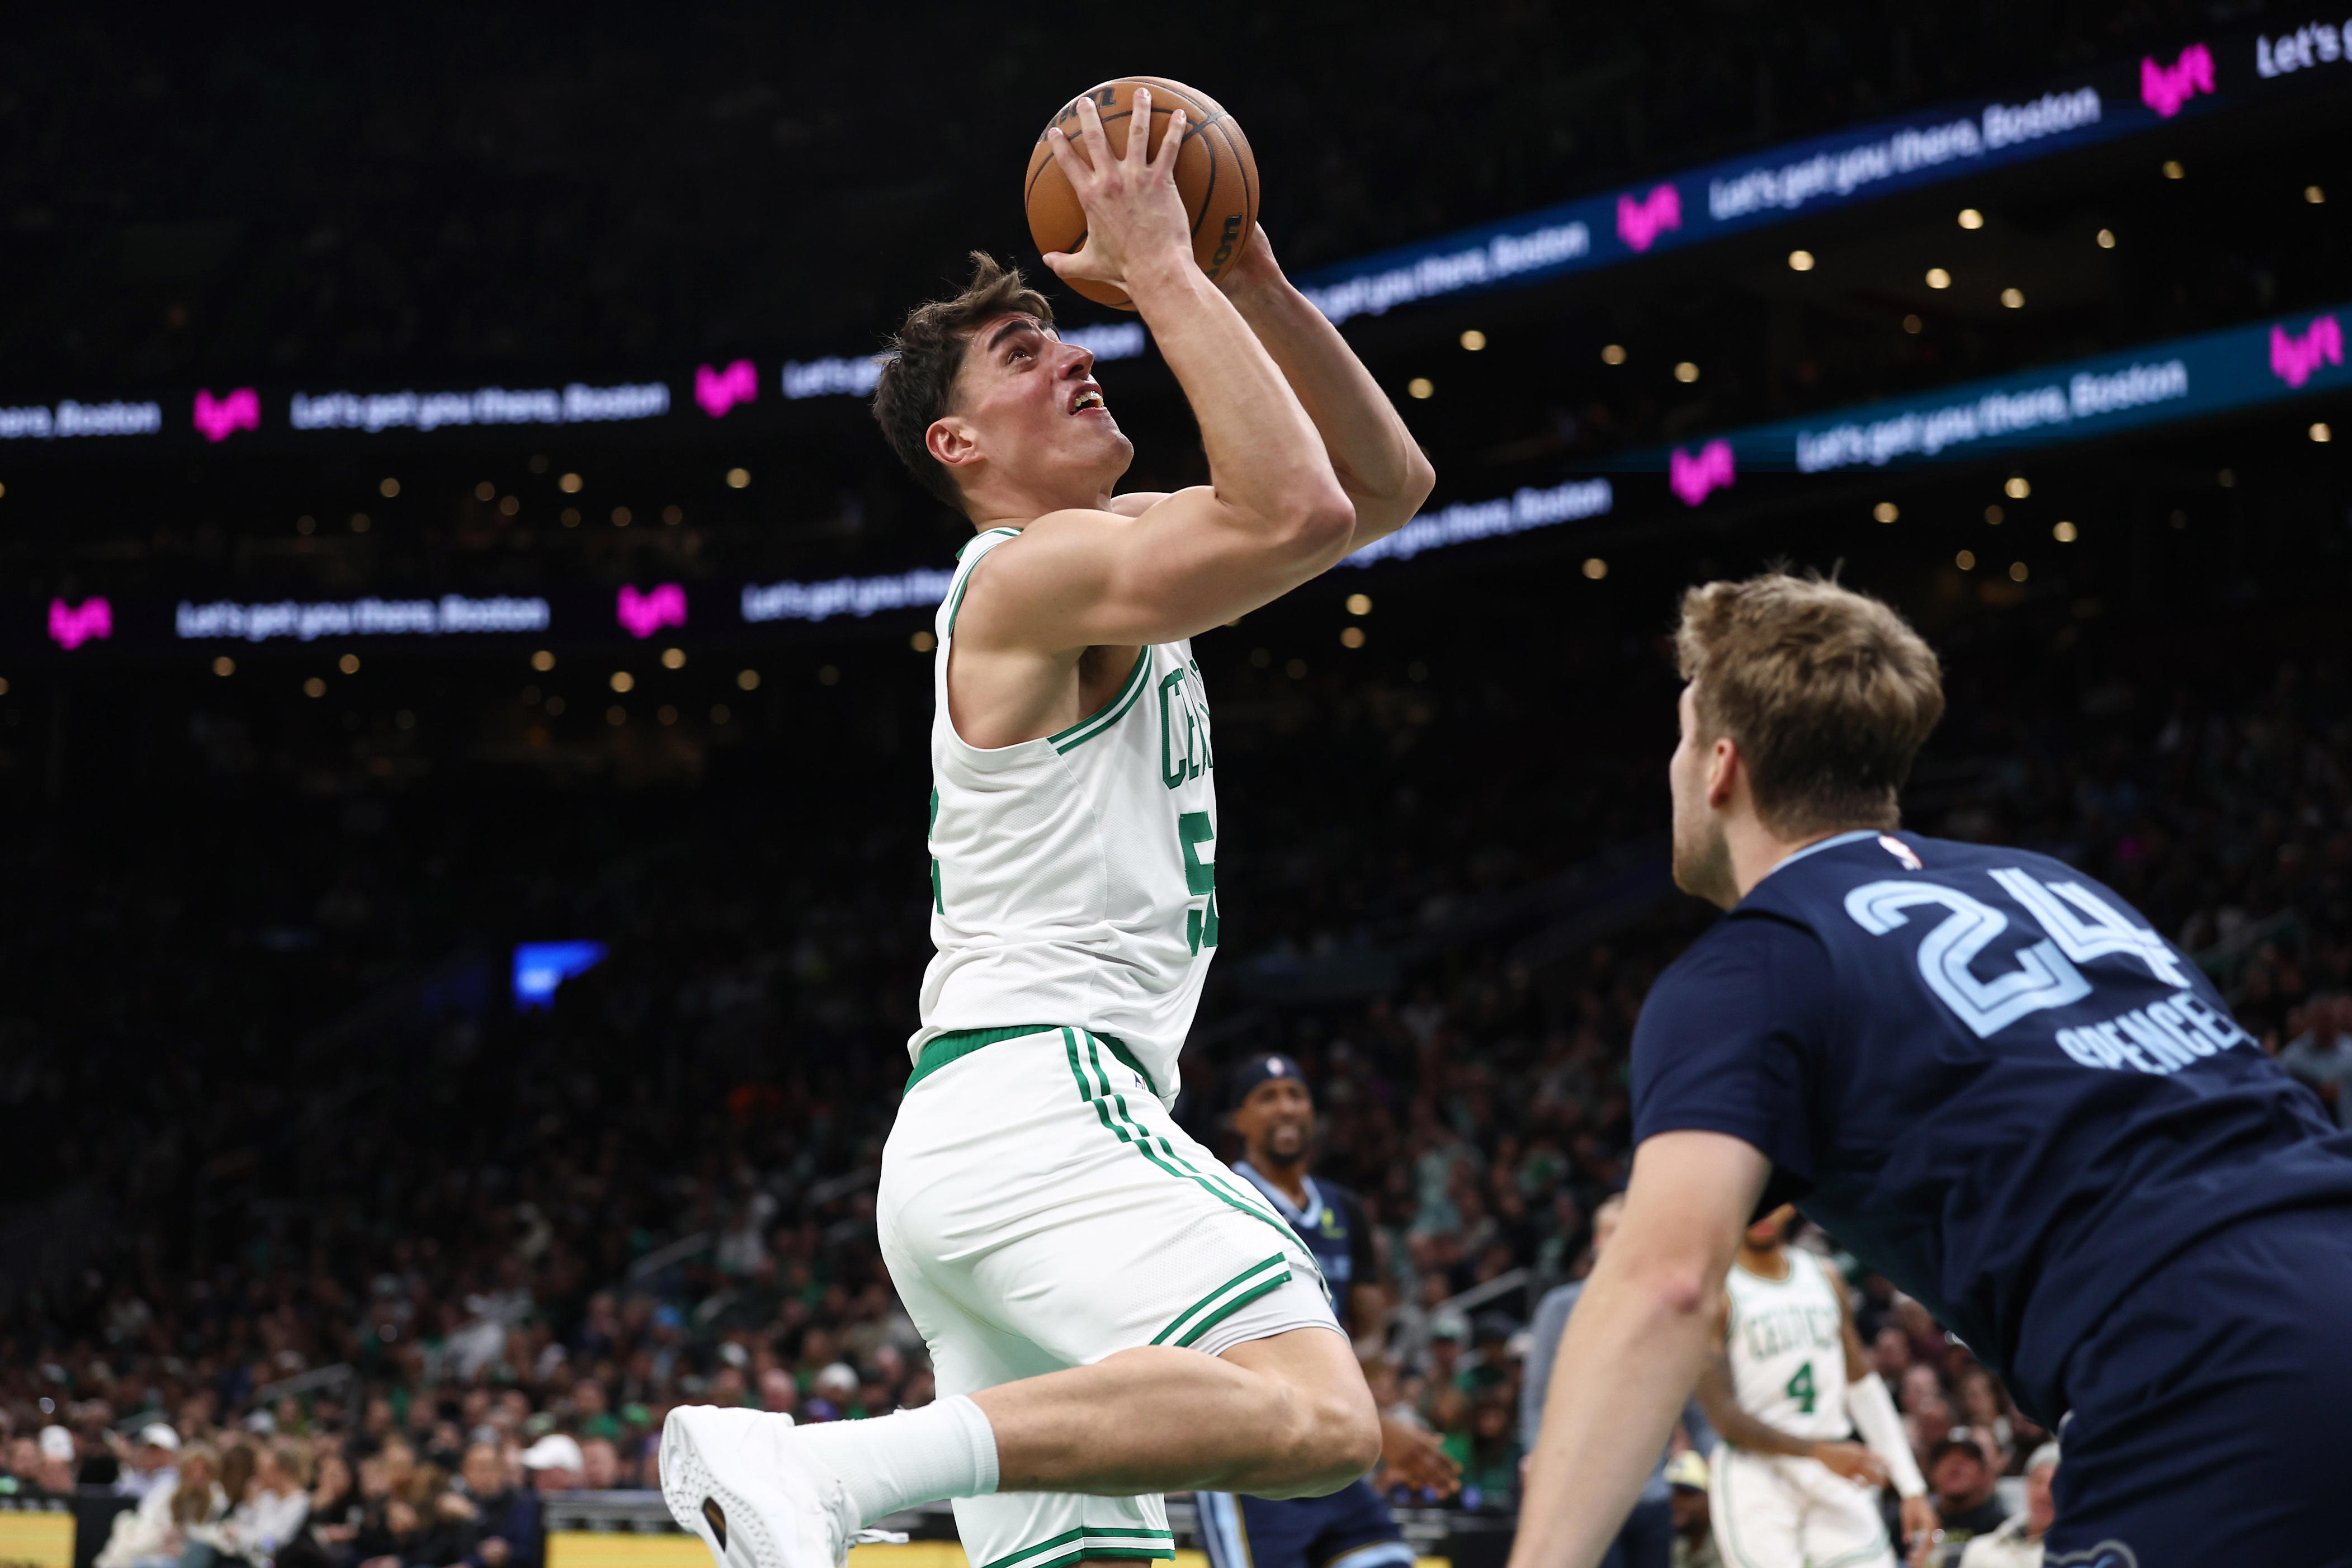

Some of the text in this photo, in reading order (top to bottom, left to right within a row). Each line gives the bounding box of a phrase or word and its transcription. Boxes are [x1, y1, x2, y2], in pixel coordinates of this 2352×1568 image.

[2256, 20, 2341, 79] Let's
[1709, 169, 1777, 220] Let's
[1776, 152, 1833, 209] get
[1834, 141, 1891, 196] you
[1982, 86, 2101, 149] Boston
[1489, 221, 1589, 278] Boston
[56, 399, 162, 437] Boston
[290, 389, 361, 430] Let's
[562, 382, 670, 423] Boston
[1795, 423, 1864, 473] Let's
[1863, 412, 1921, 466] get
[1922, 404, 1978, 456] you
[2070, 360, 2188, 417] Boston
[1513, 477, 1613, 532] Boston
[175, 600, 245, 639] Let's
[439, 593, 550, 632] Boston
[741, 579, 807, 622] Let's
[1844, 867, 2192, 1039] 24
[2055, 990, 2260, 1076] SPENCE
[1786, 1360, 1816, 1415] 4
